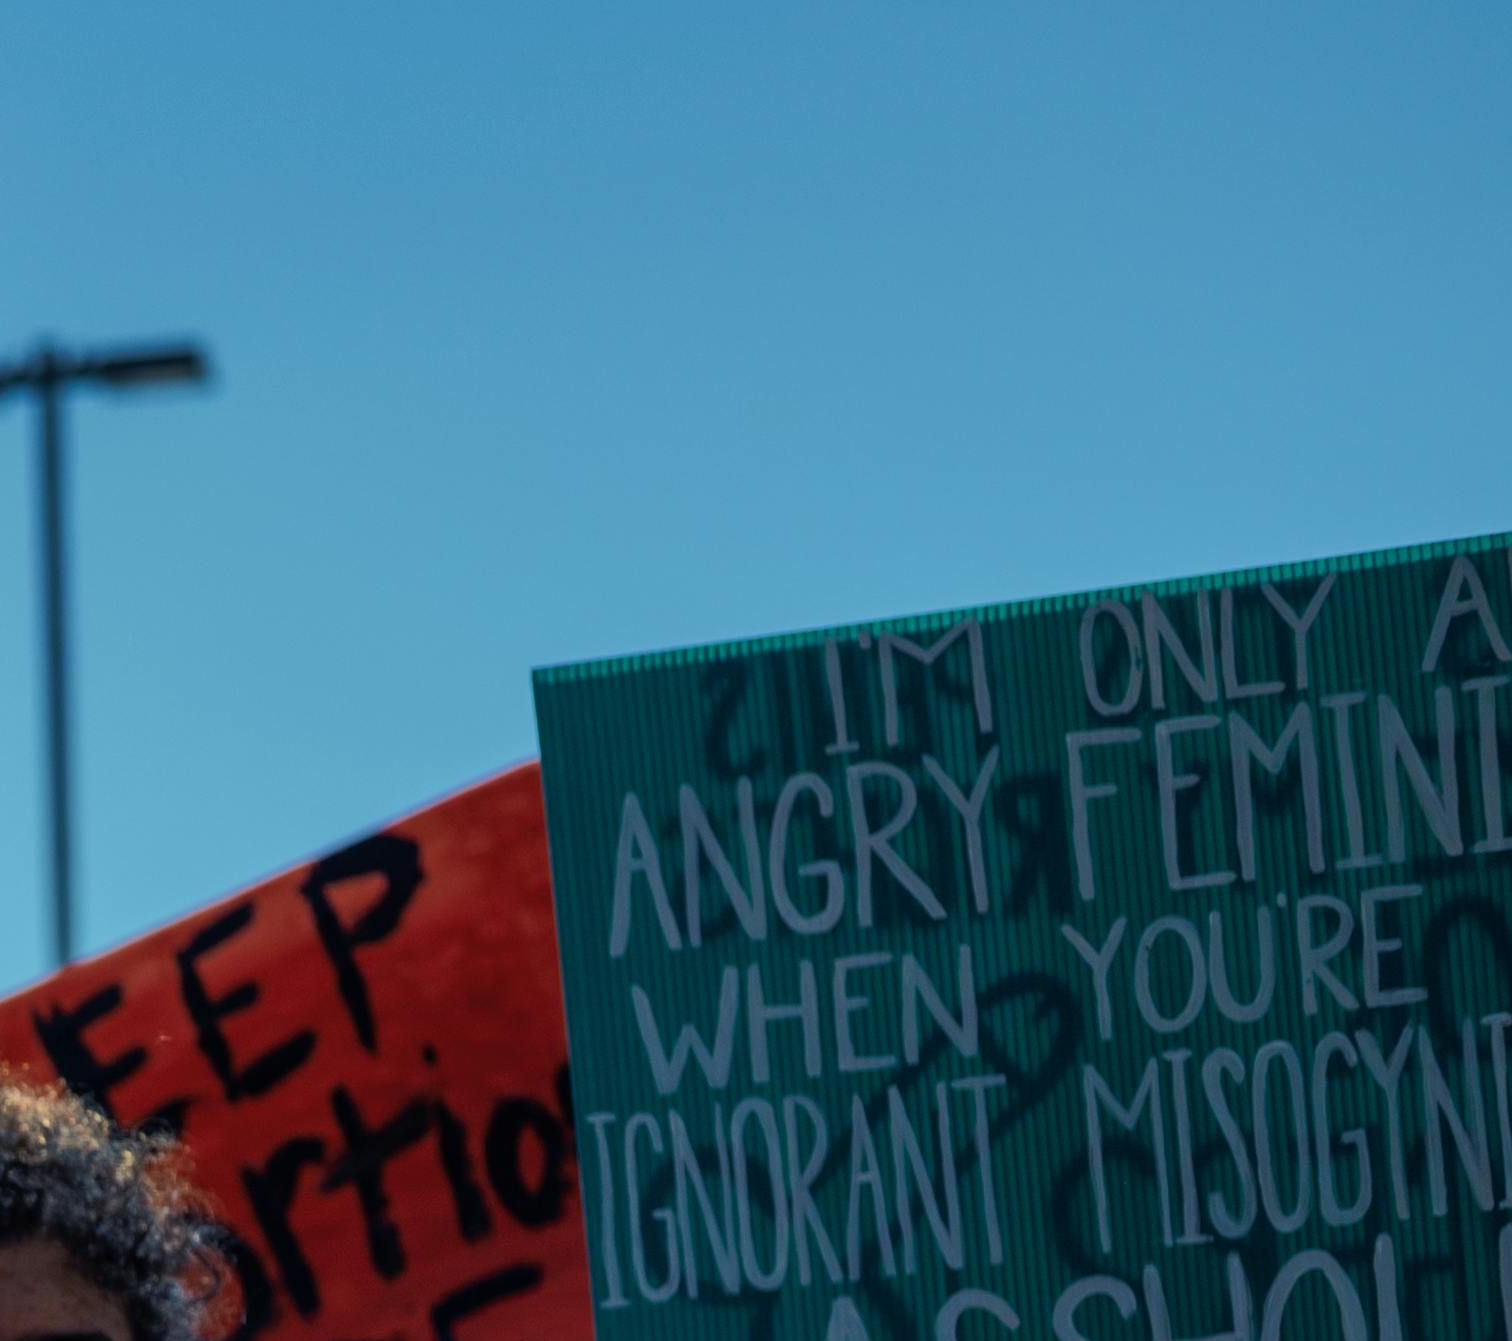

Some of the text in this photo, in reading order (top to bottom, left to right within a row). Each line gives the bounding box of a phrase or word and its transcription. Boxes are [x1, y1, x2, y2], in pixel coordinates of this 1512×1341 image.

[825, 545, 1512, 755] I'M ONLY A
[609, 745, 1001, 958] ANGRY
[632, 885, 1429, 1096] WHEN YOU'RE
[587, 1074, 1007, 1309] IGNORANT
